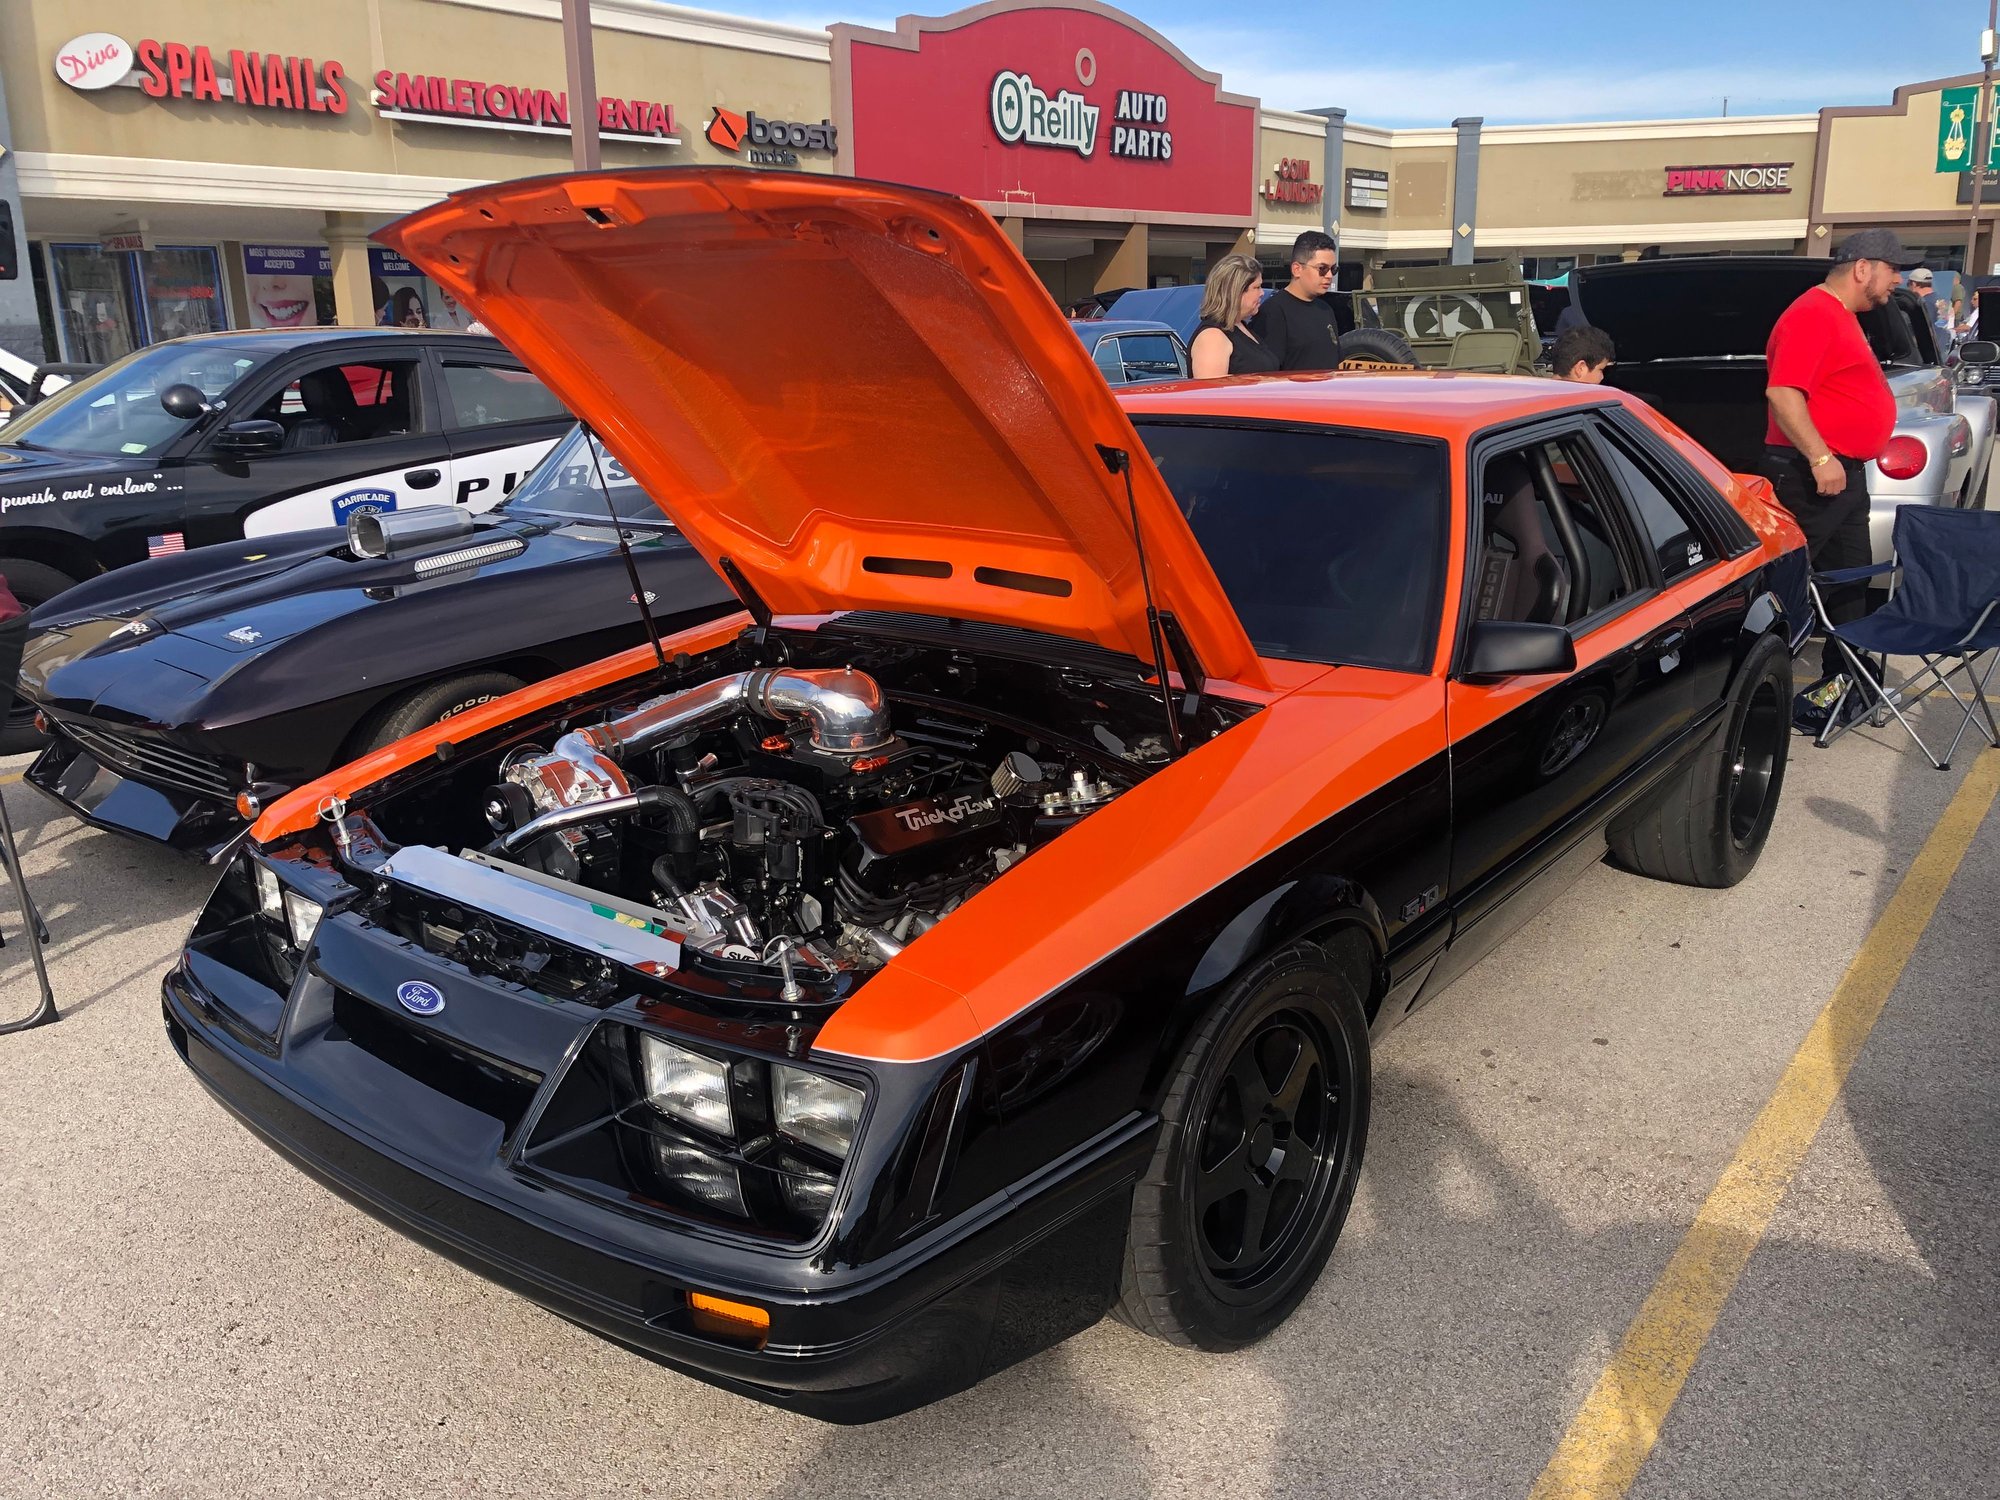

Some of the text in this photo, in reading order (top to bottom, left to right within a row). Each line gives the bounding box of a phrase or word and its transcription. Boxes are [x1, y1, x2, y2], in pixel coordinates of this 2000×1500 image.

[60, 43, 119, 82] Diva
[138, 39, 347, 114] SPA NAILS
[375, 70, 681, 134] SMILETOWN ENTAL
[997, 77, 1096, 150] O'Reilly
[1117, 91, 1167, 123] AUTO
[747, 111, 837, 152] boost
[1113, 127, 1172, 159] PARTS
[748, 149, 798, 167] mobile
[1281, 158, 1310, 179] COIN
[1265, 179, 1324, 204] LAUNDRY
[1667, 167, 1790, 191] PINK NOISE
[383, 262, 410, 270] WELCOME
[1, 487, 57, 513] punish
[62, 483, 94, 500] and
[337, 493, 391, 509] BARRICADE
[405, 985, 433, 1007] Ford
